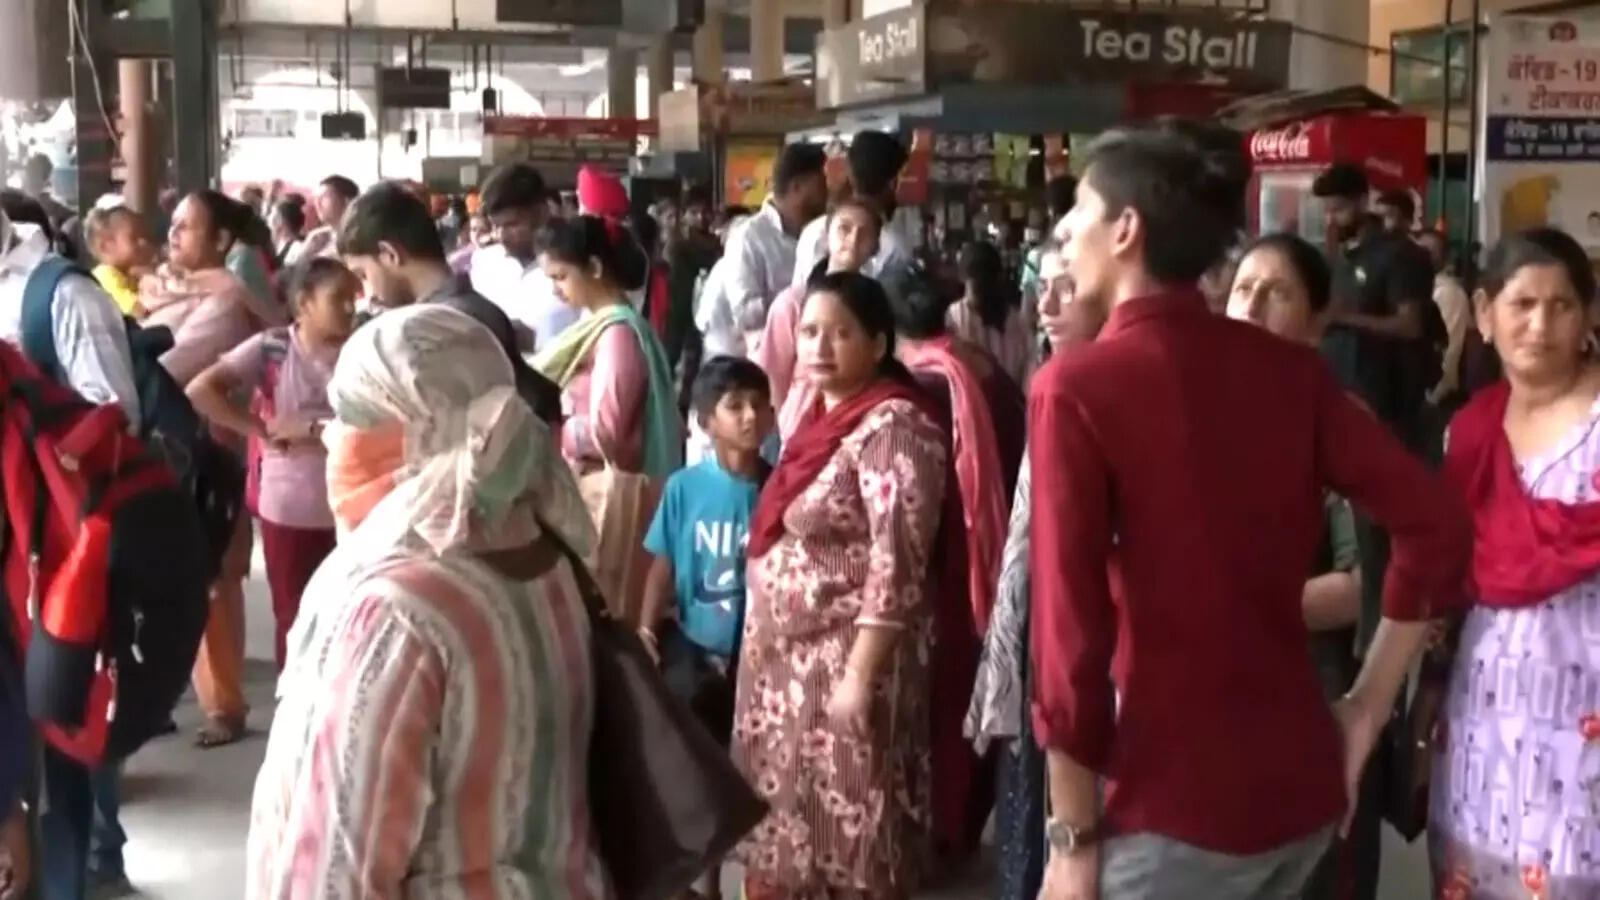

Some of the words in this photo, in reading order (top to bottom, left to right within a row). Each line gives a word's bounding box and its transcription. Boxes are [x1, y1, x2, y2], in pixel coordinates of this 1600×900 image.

[858, 30, 883, 65] Tea
[886, 18, 917, 57] Stall
[1080, 20, 1151, 60] Tea
[1163, 26, 1256, 68] Stall
